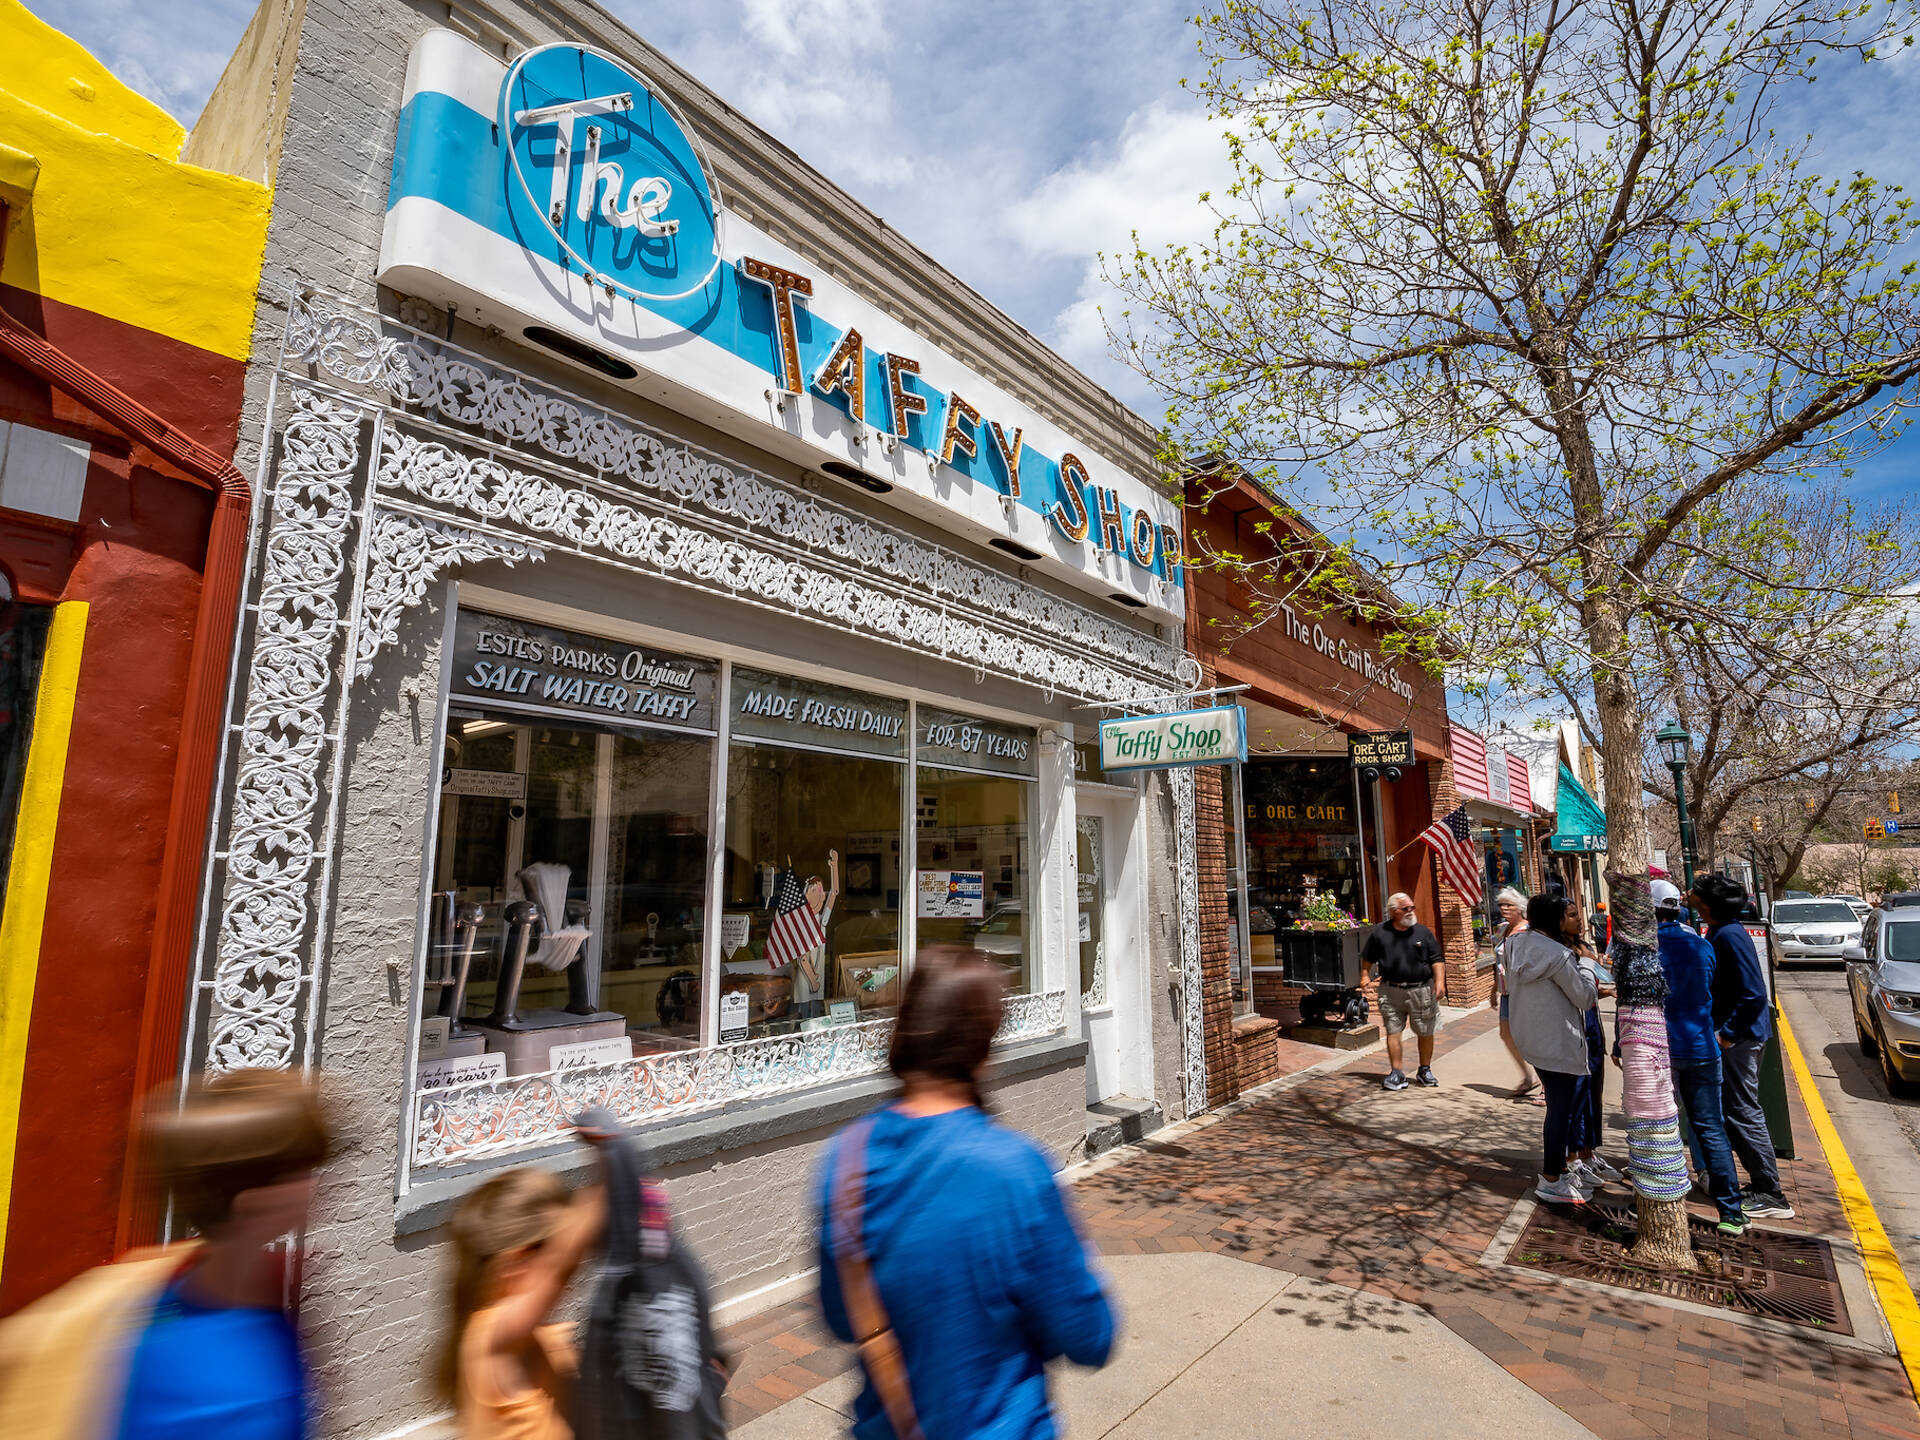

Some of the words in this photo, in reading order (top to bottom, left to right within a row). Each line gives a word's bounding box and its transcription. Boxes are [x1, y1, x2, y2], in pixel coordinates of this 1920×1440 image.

[514, 92, 680, 237] The
[737, 256, 1024, 498] TAFFY
[1055, 452, 1183, 585] SHOP
[476, 631, 544, 662] ESTES
[550, 645, 617, 677] PARK'S
[620, 651, 696, 689] Original
[1282, 603, 1310, 645] The
[1313, 623, 1335, 659] Ore
[1390, 667, 1413, 706] Shop
[465, 660, 540, 694] SALT
[543, 674, 629, 712] WATER
[632, 689, 697, 720] TAFFY
[741, 691, 798, 720] MADE
[801, 699, 858, 731] FRESH
[859, 710, 904, 738] DAILY
[926, 723, 955, 748] FOR
[960, 726, 983, 753] 87
[986, 734, 1028, 760] YEARS
[1114, 729, 1163, 761] Taffy
[1167, 720, 1221, 750] Shop
[1353, 743, 1376, 756] ORE
[1377, 741, 1408, 755] CART
[1370, 734, 1389, 743] THE
[1354, 756, 1379, 765] ROCK
[1382, 754, 1407, 763] SHOP
[1266, 805, 1297, 819] ORE
[1306, 805, 1346, 821] CART
[1583, 835, 1608, 850] FAS
[423, 1078, 440, 1090] 80
